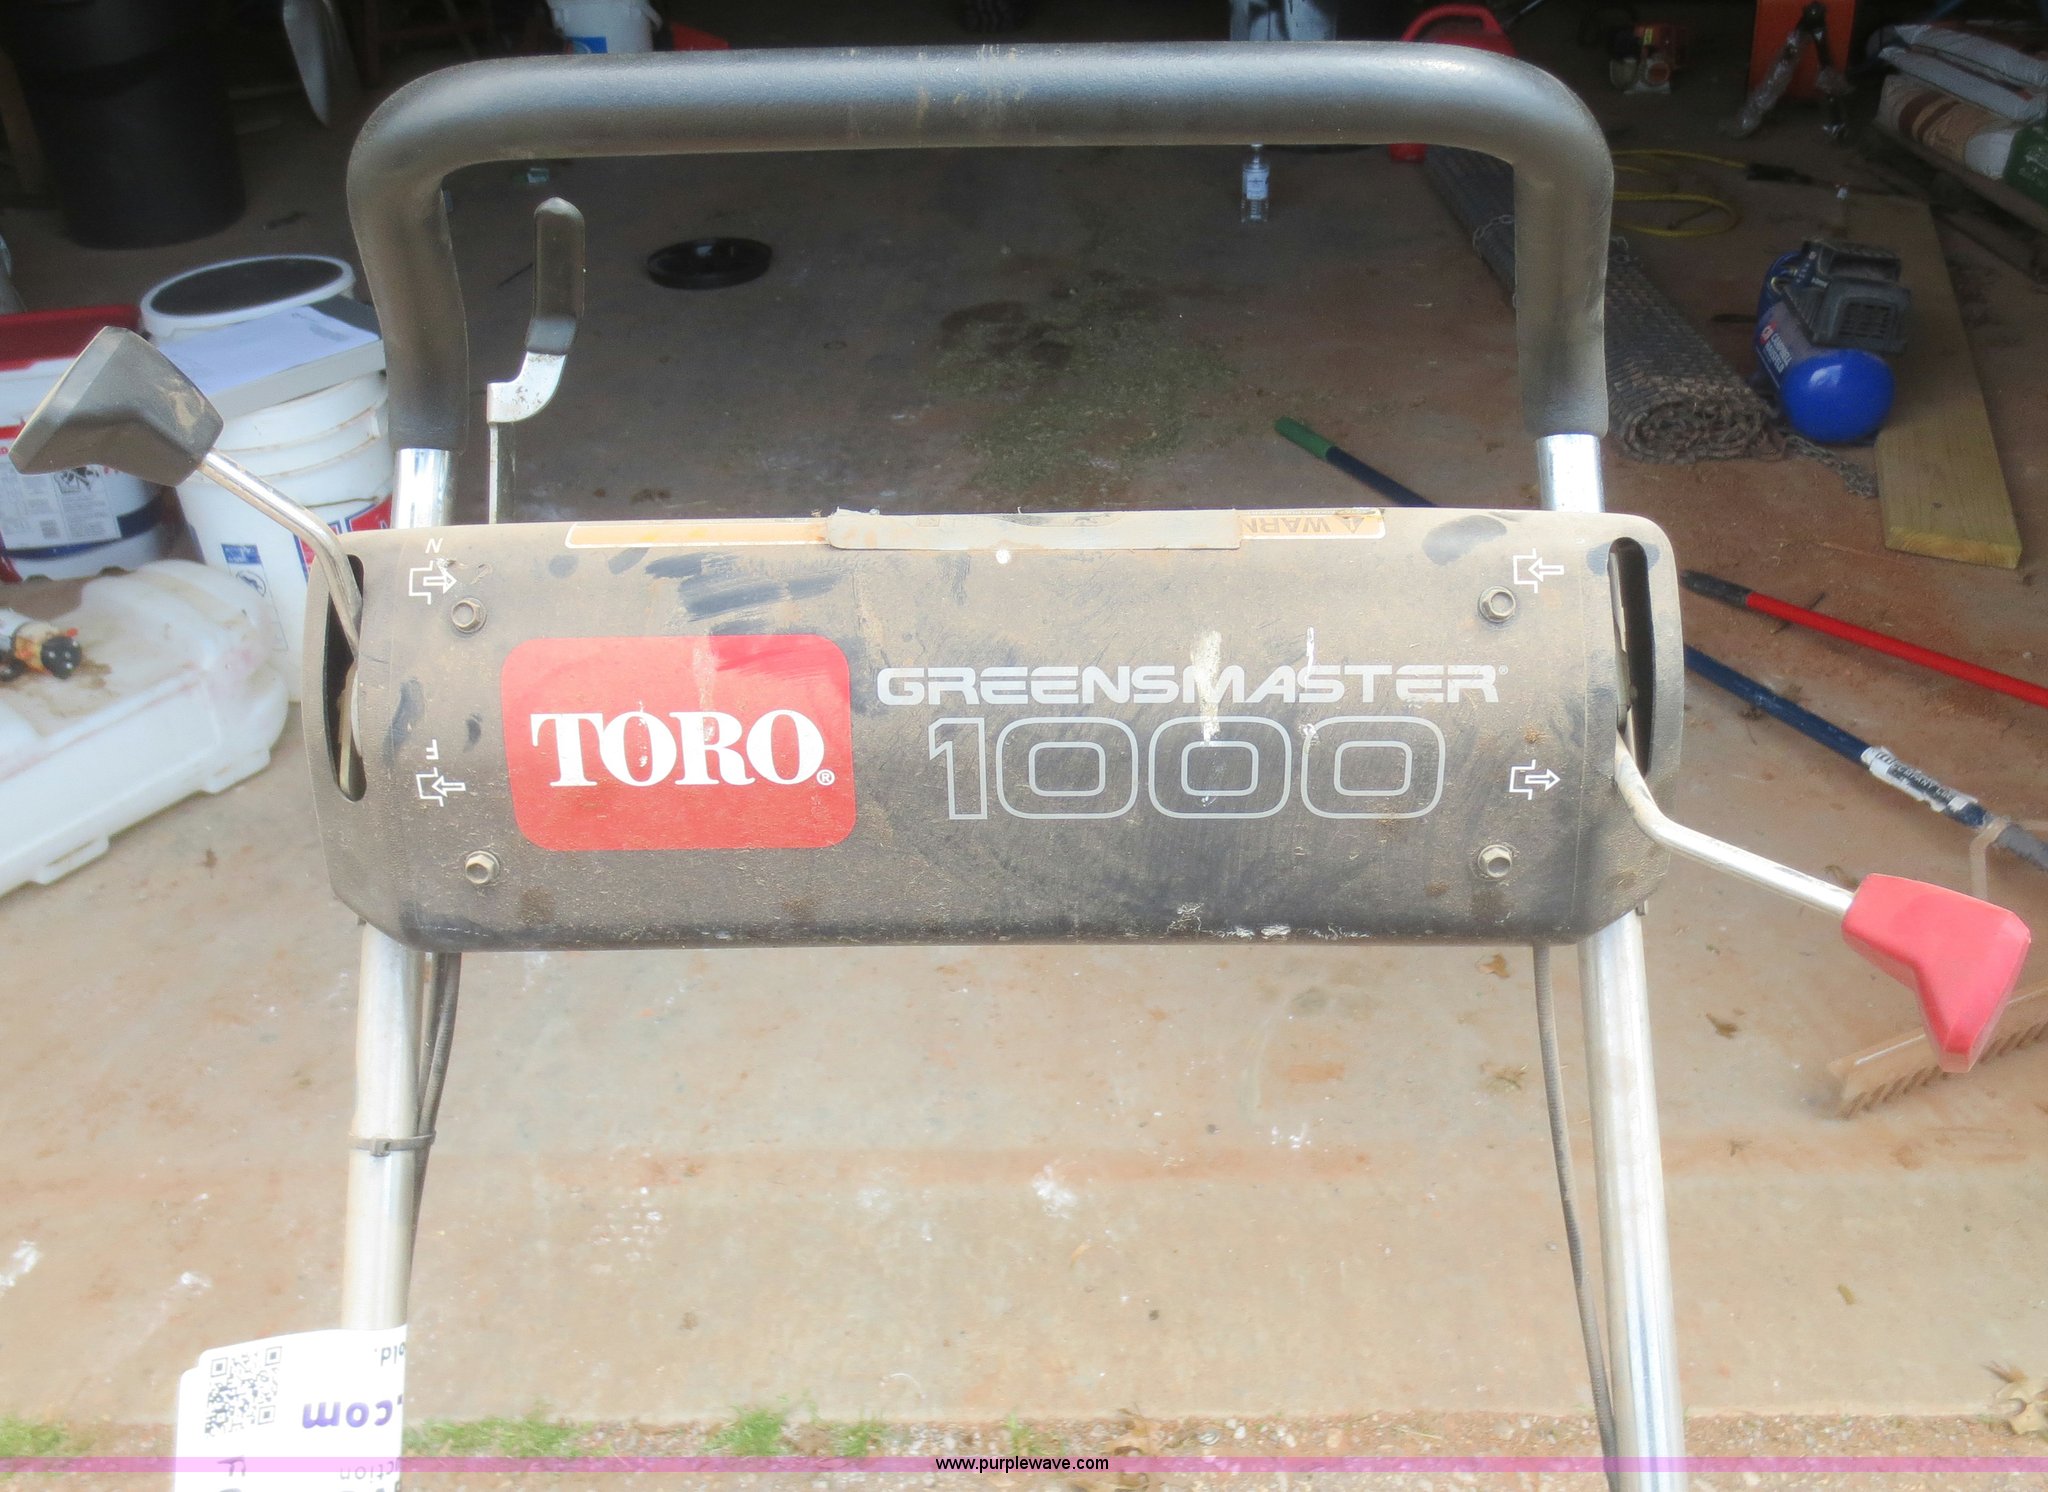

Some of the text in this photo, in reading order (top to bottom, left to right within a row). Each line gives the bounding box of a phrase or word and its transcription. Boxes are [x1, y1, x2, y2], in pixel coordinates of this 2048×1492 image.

[425, 538, 444, 554] N
[876, 664, 1501, 706] GREENSMASTER
[425, 738, 440, 761] F
[928, 715, 1447, 820] 1000
